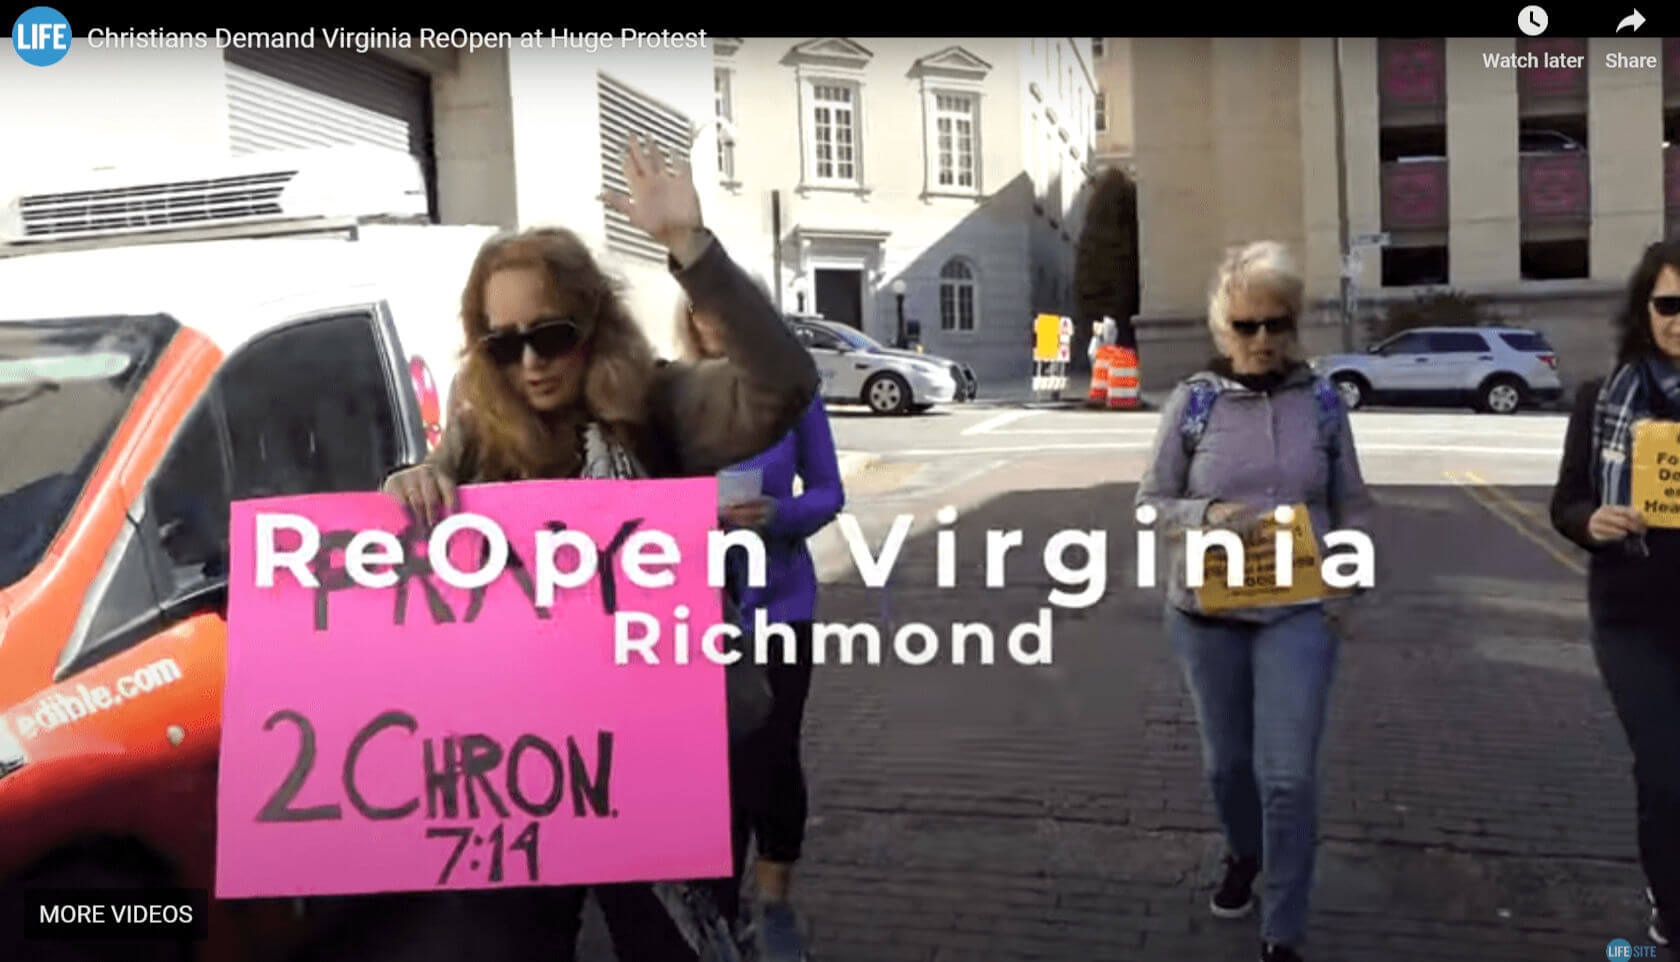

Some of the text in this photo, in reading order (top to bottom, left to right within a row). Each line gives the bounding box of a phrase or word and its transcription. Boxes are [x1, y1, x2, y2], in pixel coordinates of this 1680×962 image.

[16, 658, 183, 740] edible.com
[253, 709, 343, 823] 2
[424, 821, 541, 886] 7:14
